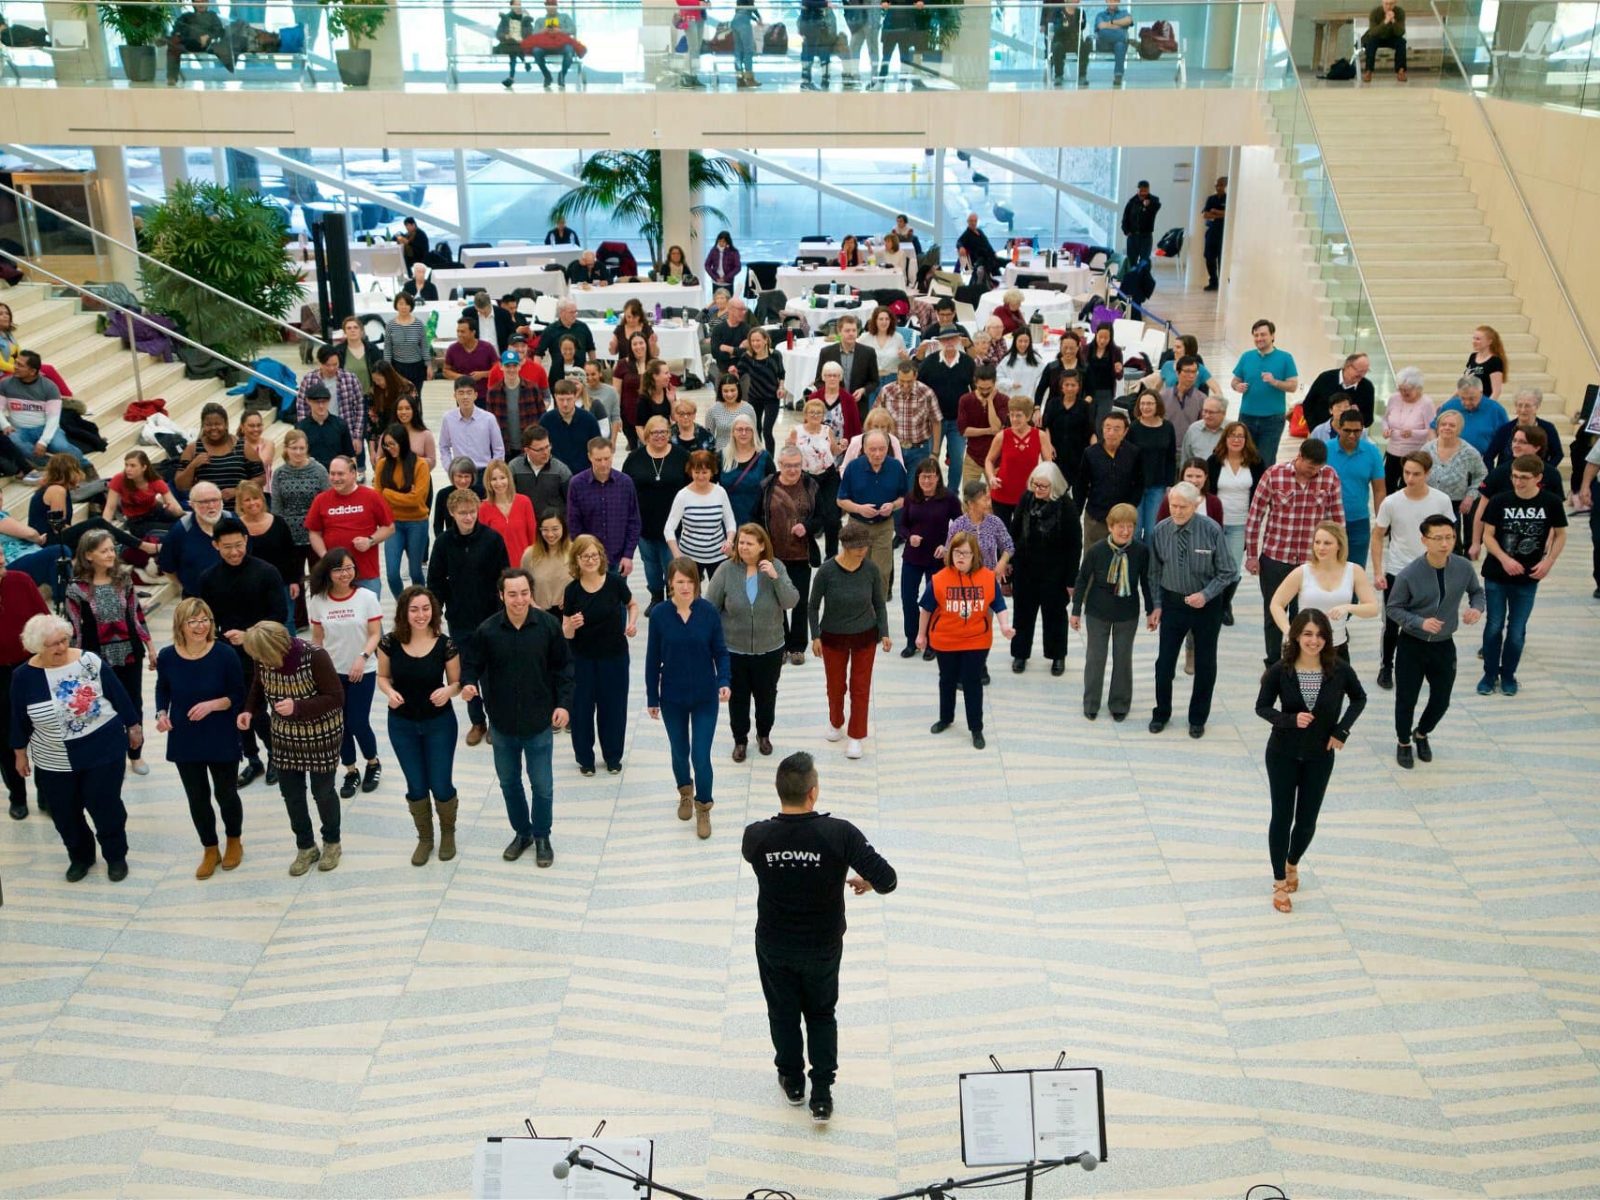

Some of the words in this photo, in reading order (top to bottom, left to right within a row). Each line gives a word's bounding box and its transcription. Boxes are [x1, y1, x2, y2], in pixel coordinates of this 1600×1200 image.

[328, 505, 364, 515] adidas
[1504, 507, 1547, 519] NASA
[946, 587, 984, 600] OILERS
[946, 600, 985, 612] HOCKEY
[765, 851, 821, 862] ETOWN
